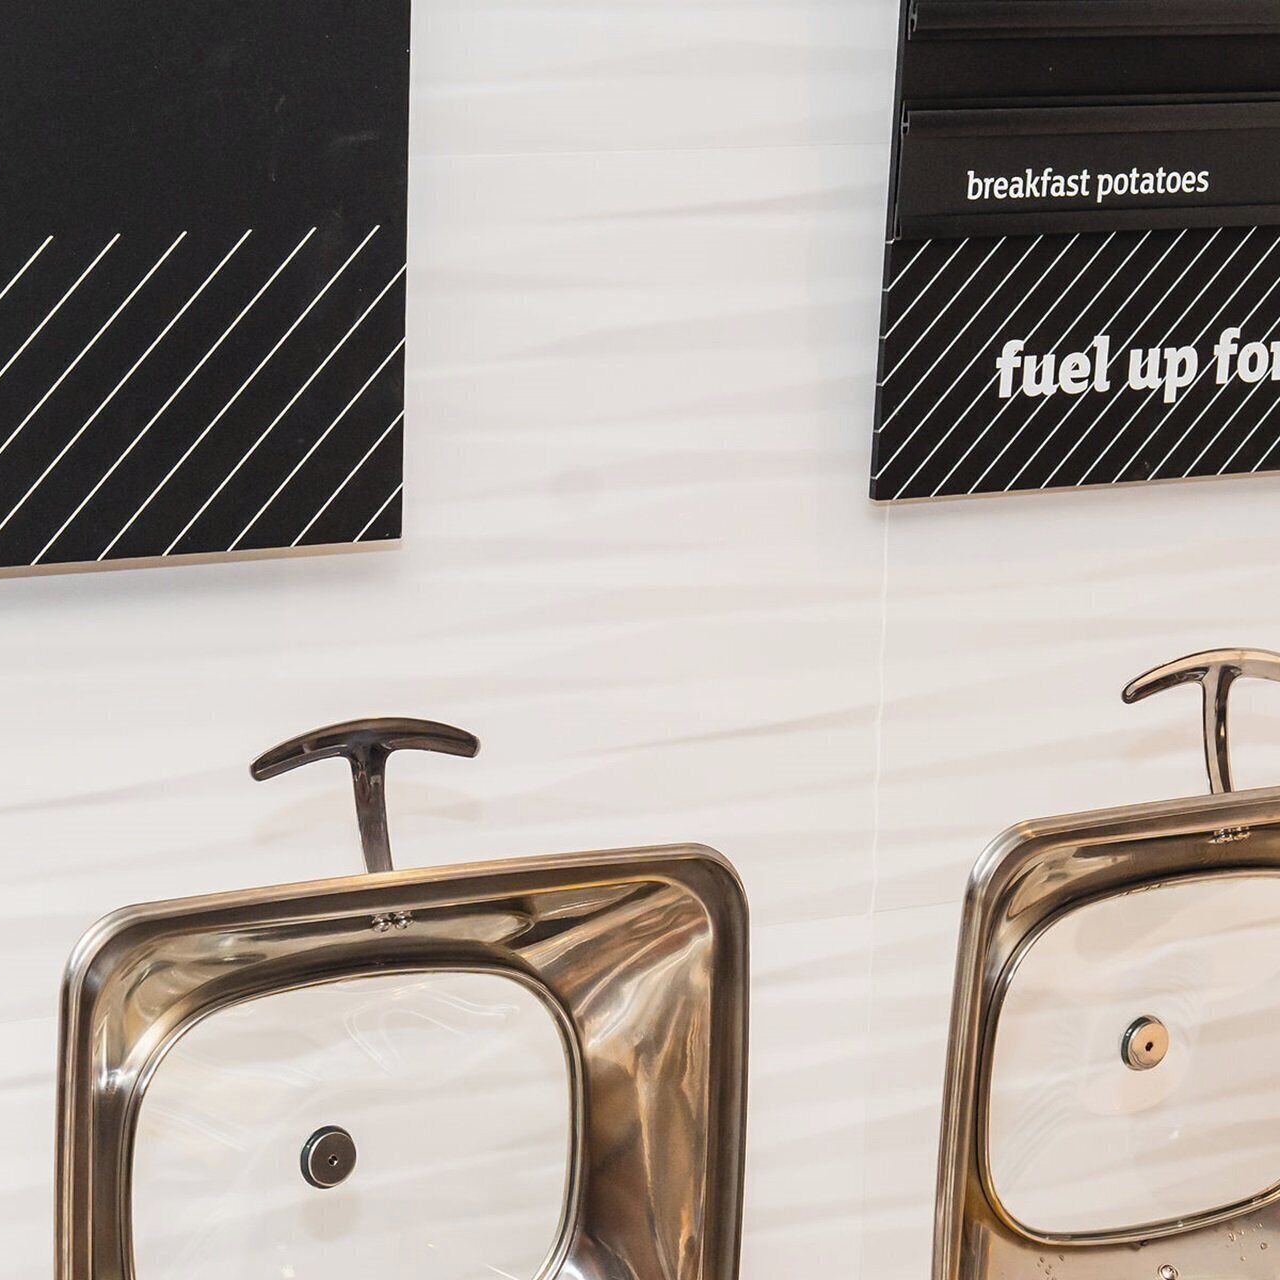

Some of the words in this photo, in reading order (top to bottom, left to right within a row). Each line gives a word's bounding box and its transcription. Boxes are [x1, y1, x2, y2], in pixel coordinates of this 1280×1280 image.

[967, 167, 1091, 200] breakfast
[1096, 166, 1210, 204] potatoes
[994, 336, 1110, 398] fuel
[1128, 345, 1199, 404] up
